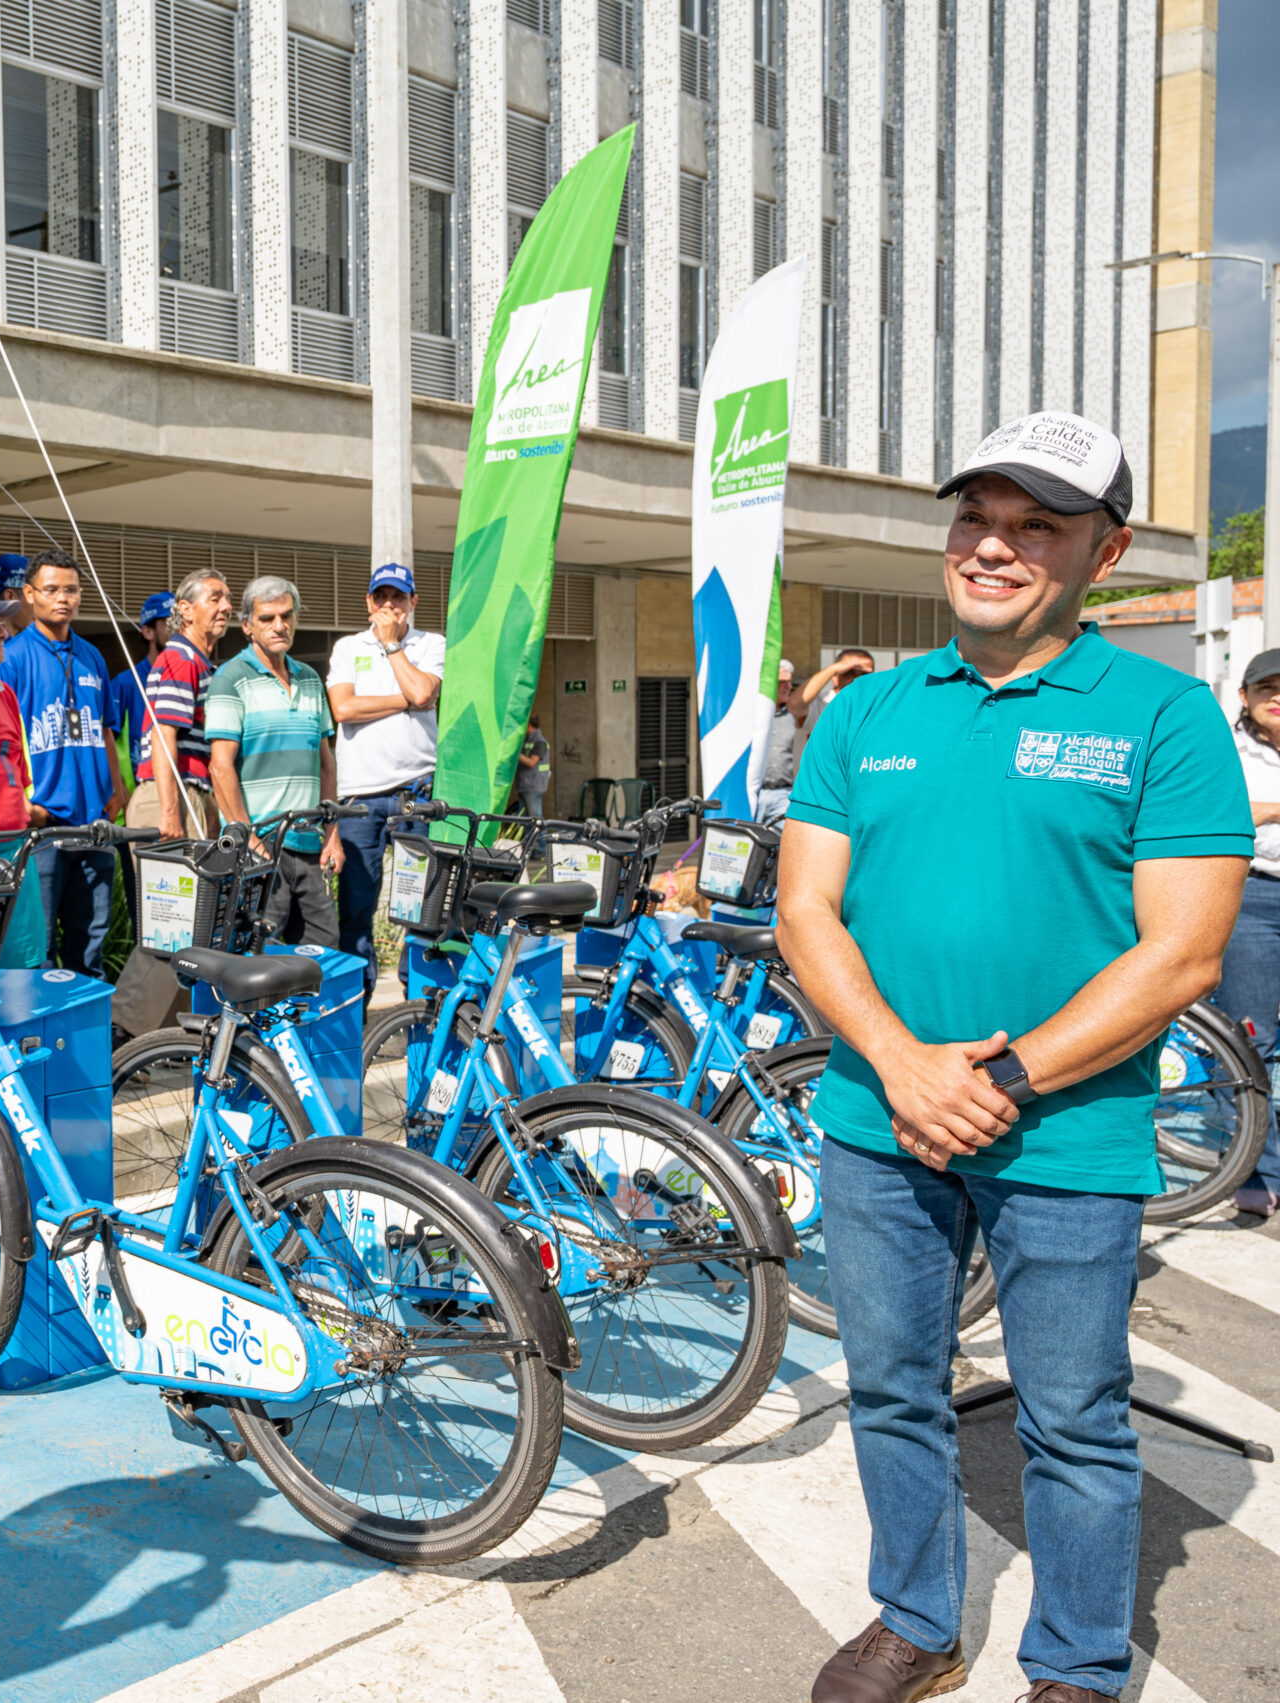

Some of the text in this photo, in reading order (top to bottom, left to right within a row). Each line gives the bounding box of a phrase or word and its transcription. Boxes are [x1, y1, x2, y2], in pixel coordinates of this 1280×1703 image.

[1032, 424, 1093, 451] Caldas
[1085, 431, 1098, 440] de
[1028, 434, 1088, 457] Antioquia
[1062, 734, 1132, 751] Alcaldía de
[1062, 755, 1124, 771] Antioquia
[1065, 746, 1126, 762] Caldas
[859, 755, 917, 773] Alcalde
[749, 1021, 776, 1045] 3812
[609, 1049, 637, 1073] 3755
